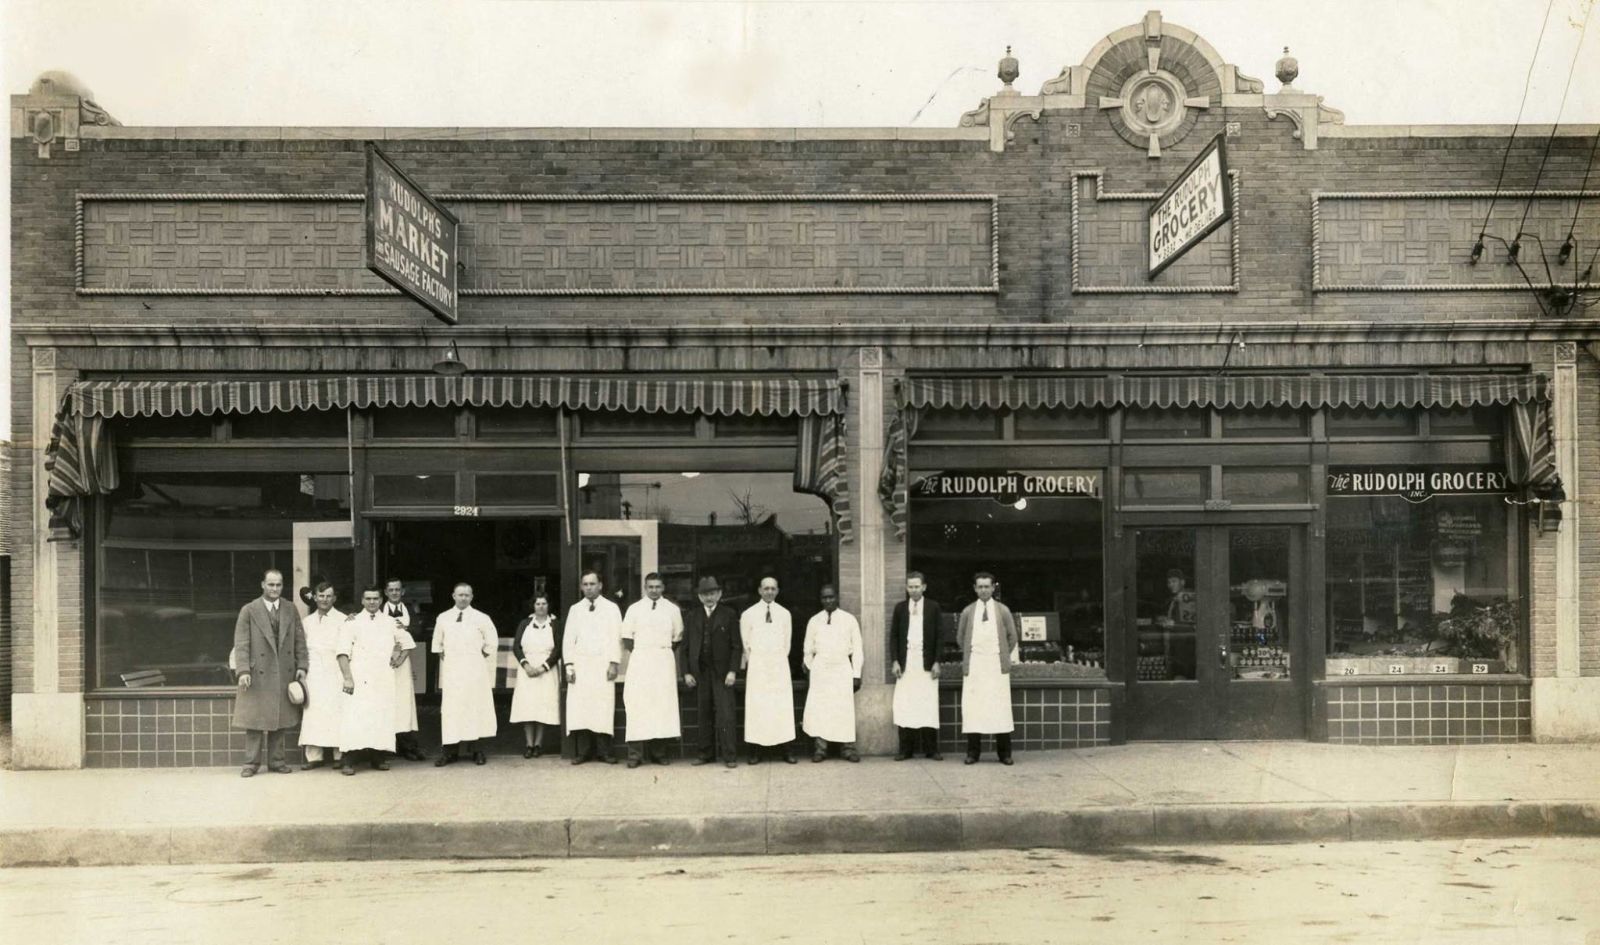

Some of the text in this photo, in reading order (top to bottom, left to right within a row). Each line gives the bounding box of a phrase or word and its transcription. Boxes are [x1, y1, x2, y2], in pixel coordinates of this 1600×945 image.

[389, 176, 441, 239] RUDOLPH'S
[1153, 173, 1220, 253] GROCERY
[1157, 159, 1211, 226] THE RUDOLPH
[379, 198, 449, 278] MARKET
[384, 242, 420, 286] SAUSAGE
[421, 270, 452, 309] FACTORY
[917, 475, 1097, 494] The RUDOLPH GROCERY
[1328, 471, 1510, 491] The RUDOLPH GROCERY
[453, 505, 479, 517] 2924
[1344, 667, 1355, 675] 20
[1475, 665, 1486, 673] 29
